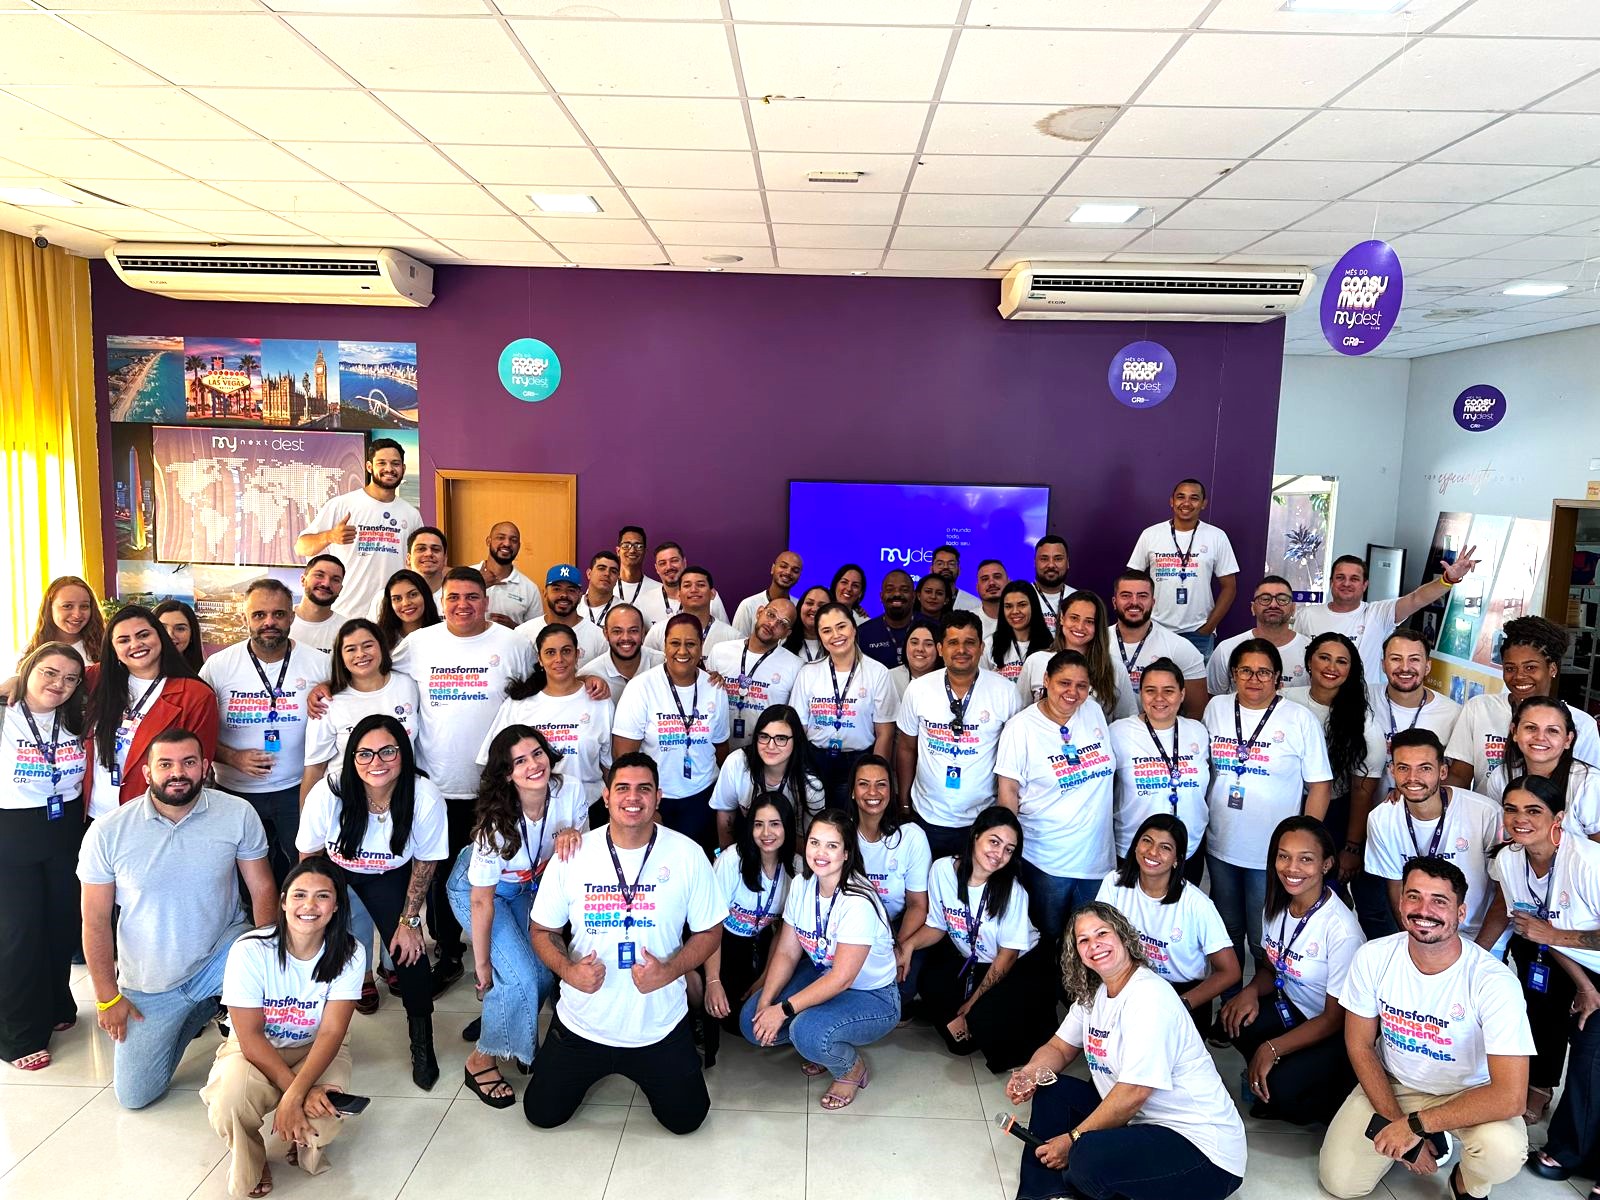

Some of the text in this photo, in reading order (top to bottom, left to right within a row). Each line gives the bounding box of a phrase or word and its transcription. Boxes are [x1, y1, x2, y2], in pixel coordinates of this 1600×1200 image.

[1341, 276, 1389, 294] consu
[1337, 288, 1379, 309] midor
[1123, 362, 1163, 372] consu
[212, 436, 237, 452] my
[271, 437, 304, 451] dest
[358, 524, 401, 533] Transformar
[881, 547, 933, 567] myde
[431, 666, 488, 674] Transformar
[430, 691, 488, 700] memoráveis.
[584, 911, 612, 919] reais
[1424, 1022, 1440, 1034] em
